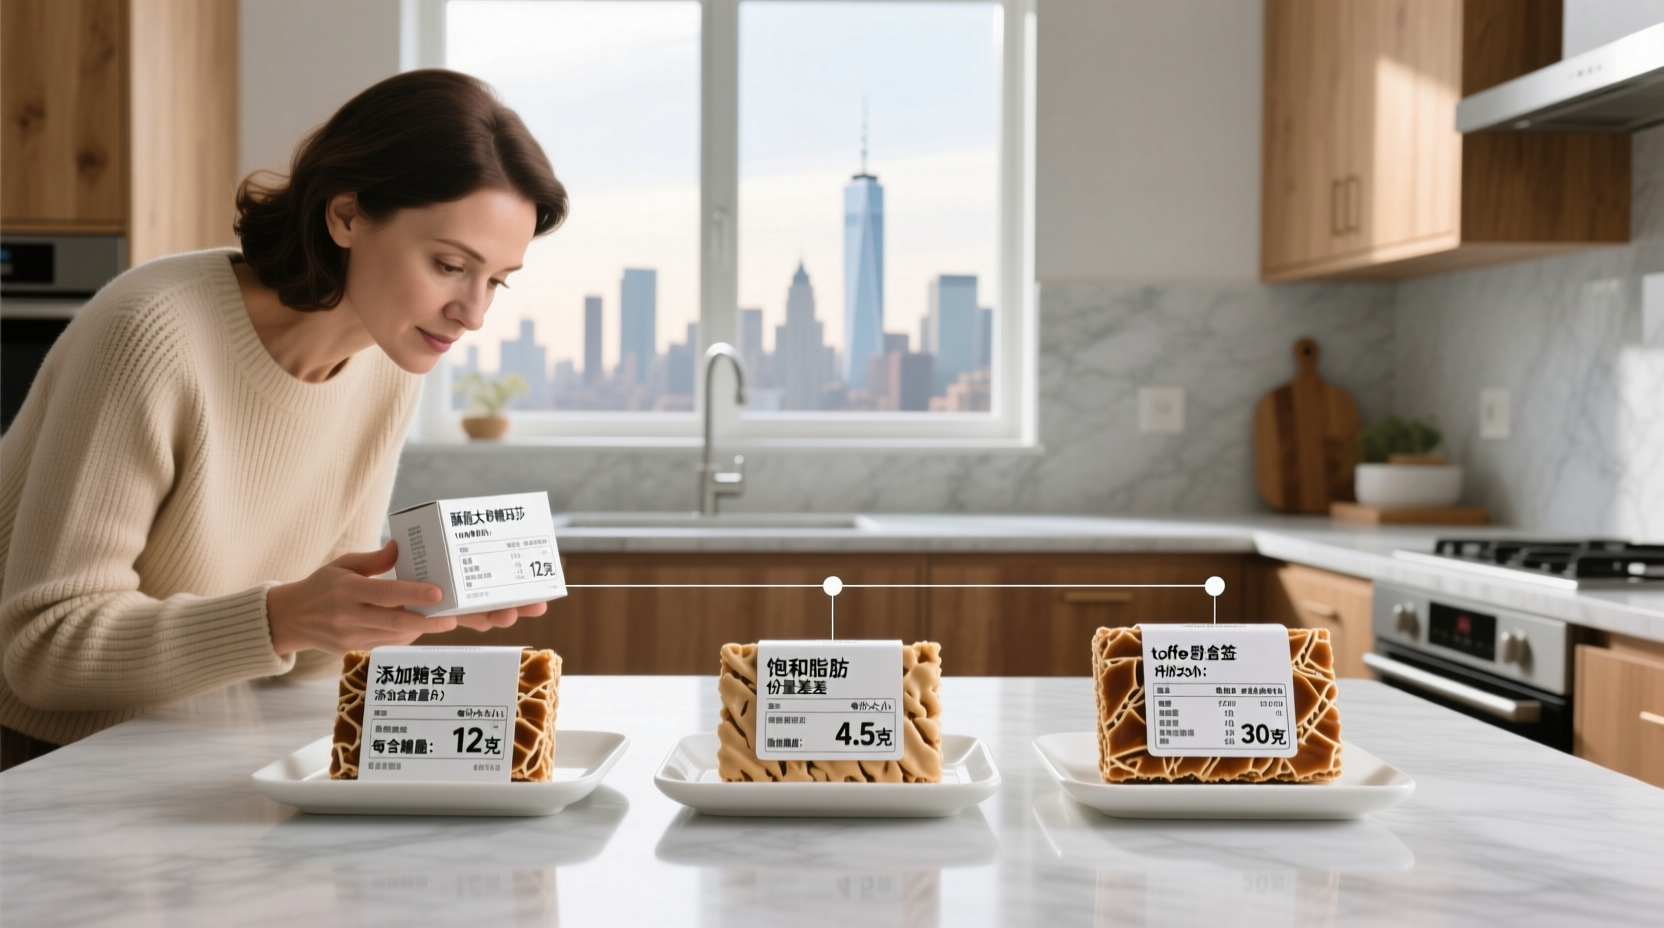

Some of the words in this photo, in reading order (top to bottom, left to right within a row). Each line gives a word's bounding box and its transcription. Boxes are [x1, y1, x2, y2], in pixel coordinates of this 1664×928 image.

[375, 664, 466, 686] 添加糖含量
[766, 656, 850, 679] 饱和脂肪
[452, 727, 502, 755] 12克
[835, 721, 893, 747] 4.5克
[1240, 723, 1287, 746] 30克
